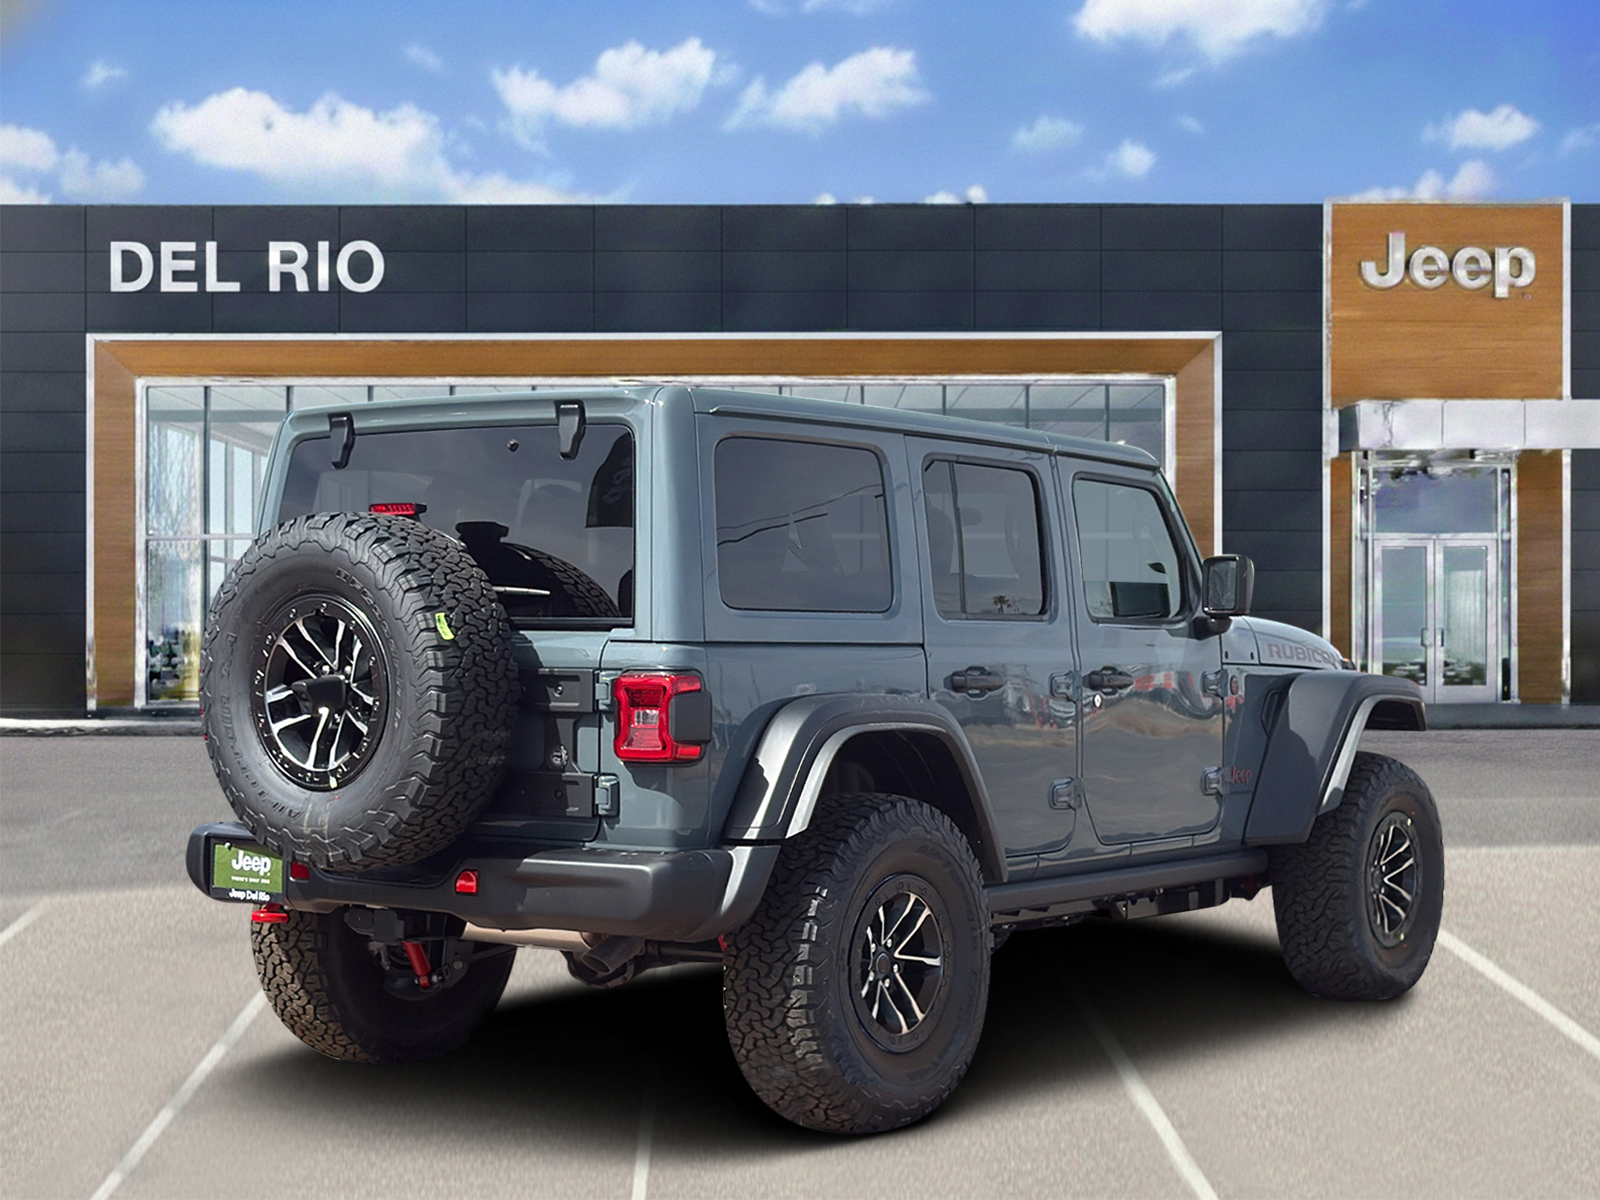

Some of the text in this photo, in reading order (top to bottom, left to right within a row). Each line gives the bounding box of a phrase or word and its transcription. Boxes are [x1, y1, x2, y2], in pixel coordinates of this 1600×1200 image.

[110, 240, 385, 293] DEL RIO
[1359, 231, 1537, 299] Jeep
[1267, 643, 1340, 669] RUBICON
[1229, 765, 1252, 786] Jeep
[231, 849, 271, 876] Jeep
